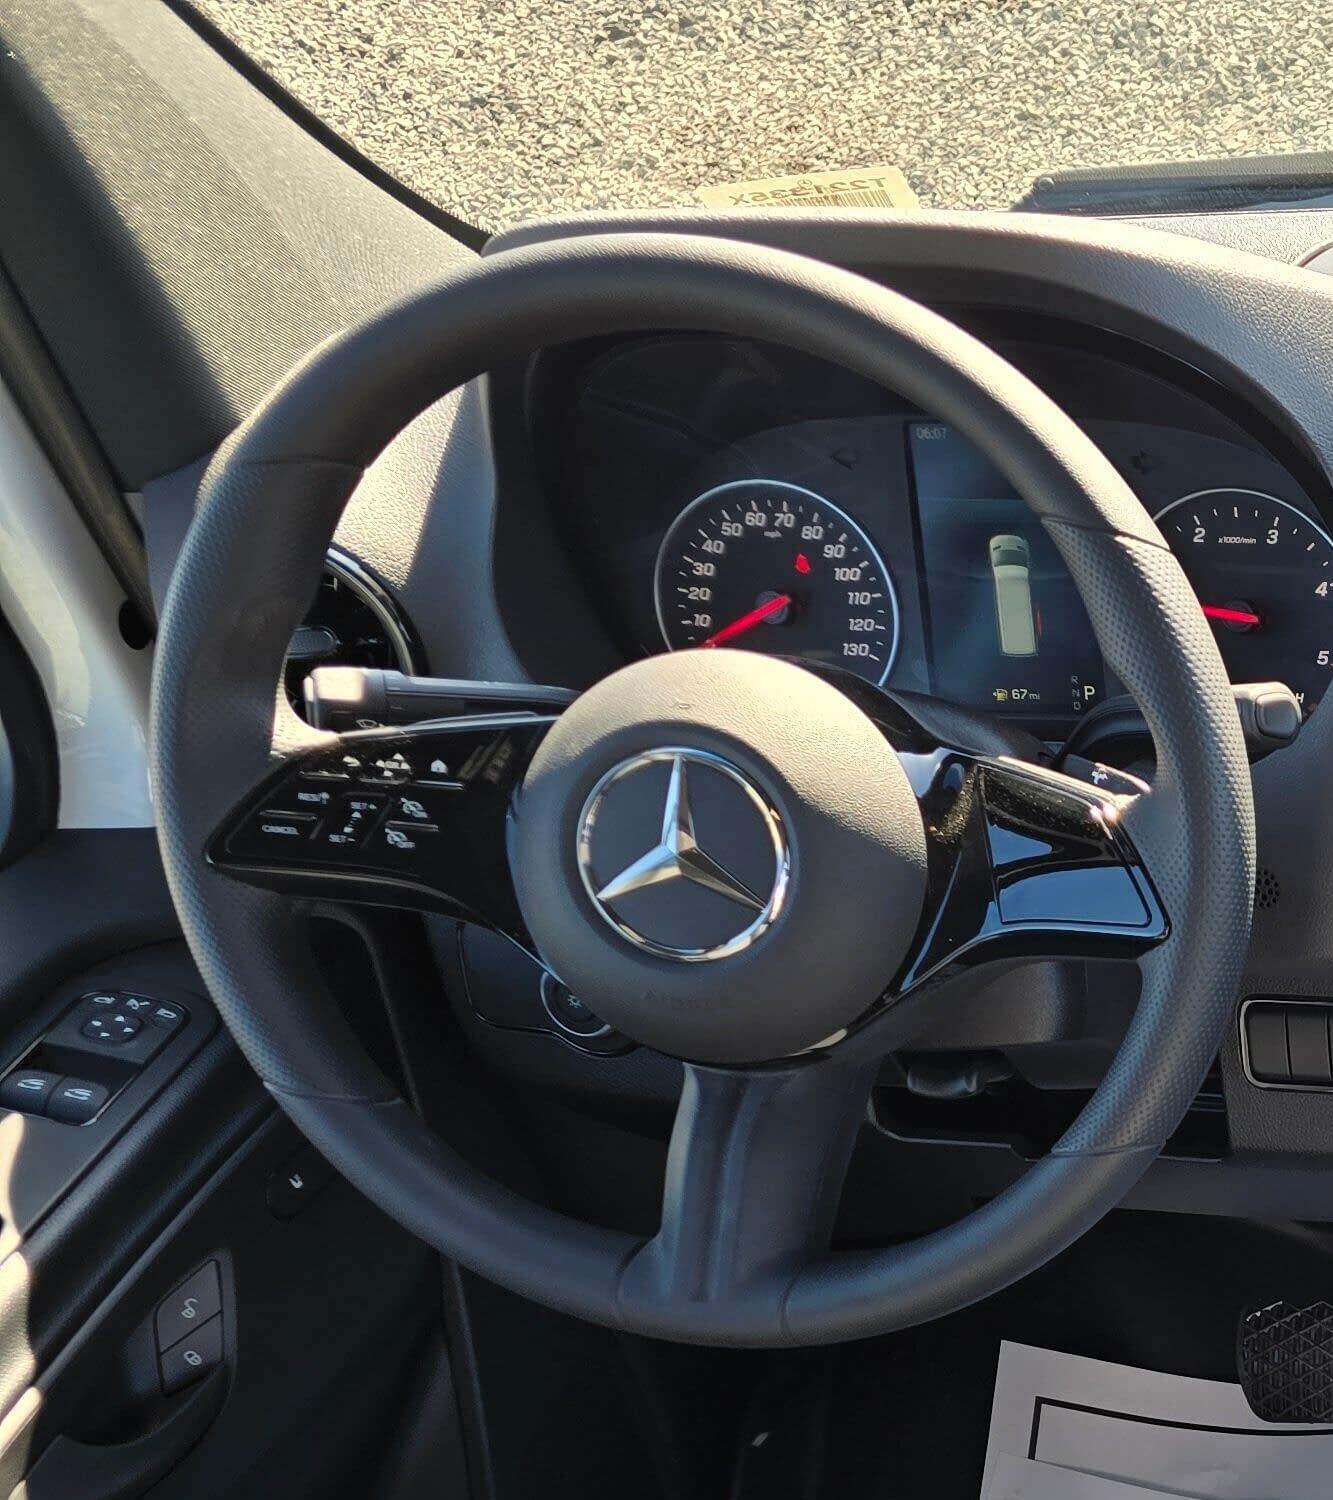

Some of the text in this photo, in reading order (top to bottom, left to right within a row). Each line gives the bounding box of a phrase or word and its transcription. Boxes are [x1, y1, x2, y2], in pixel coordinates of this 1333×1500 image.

[745, 513, 766, 527] 60
[774, 513, 795, 528] 70
[721, 522, 743, 537] 50
[802, 526, 823, 540] 80
[1193, 527, 1205, 543] 2
[1266, 529, 1279, 545] 3
[701, 540, 725, 554] 40
[823, 544, 845, 558] 90
[692, 563, 715, 577] 30
[834, 567, 861, 581] 100
[688, 587, 711, 600] 20
[1314, 581, 1328, 597] 4
[848, 592, 871, 605] 110
[694, 613, 711, 627] 10
[849, 618, 875, 632] 120
[843, 643, 869, 656] 130
[1316, 651, 1330, 665] 5
[1011, 689, 1028, 700] 67
[1084, 685, 1096, 700] P
